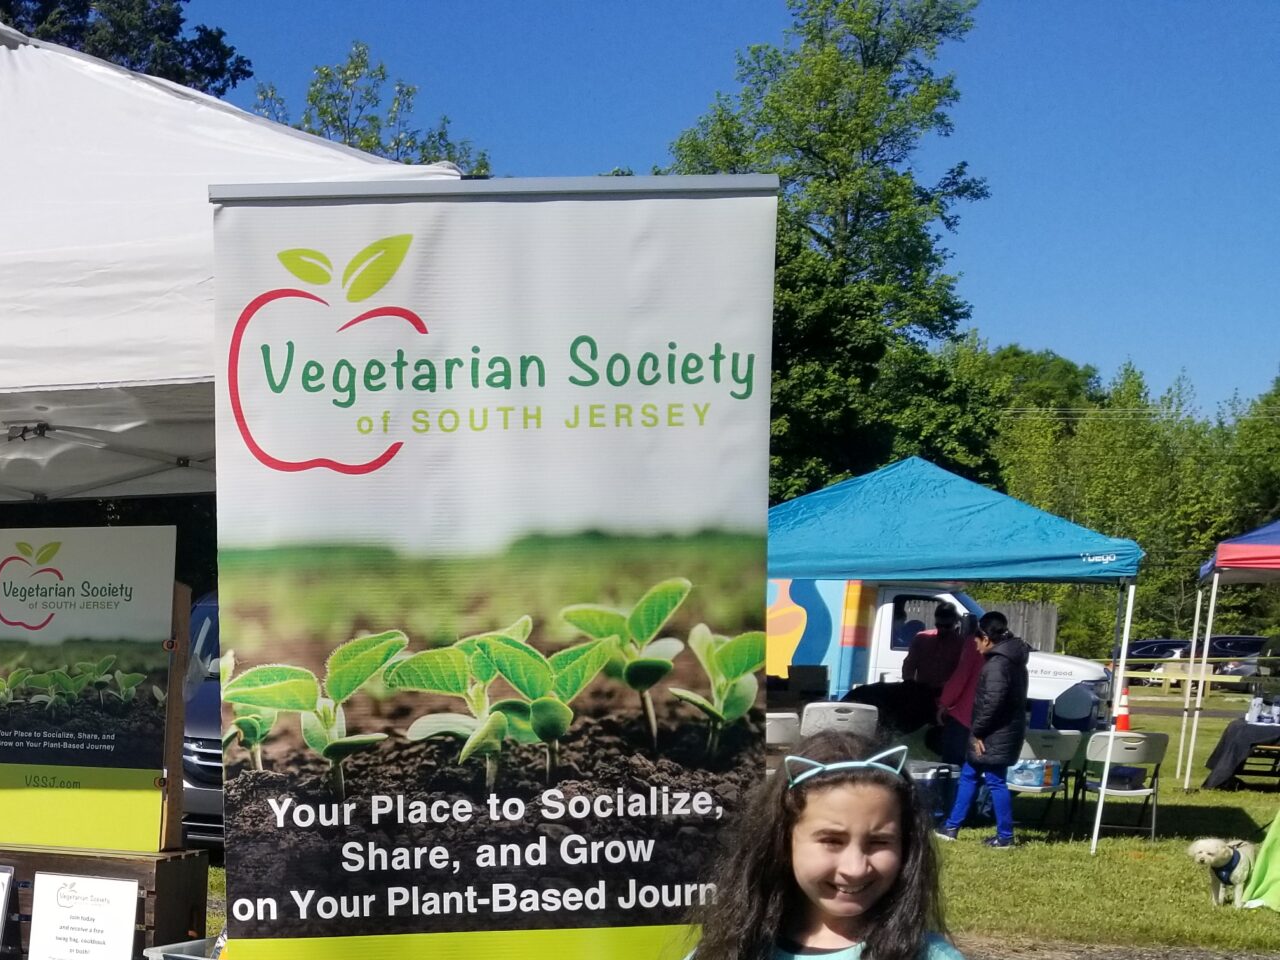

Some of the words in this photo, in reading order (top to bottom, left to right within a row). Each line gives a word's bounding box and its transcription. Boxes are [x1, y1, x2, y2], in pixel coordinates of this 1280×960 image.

[261, 340, 546, 408] Vegetarian
[568, 335, 756, 399] Society
[356, 409, 391, 434] of
[412, 405, 543, 433] SOUTH
[565, 402, 712, 429] JERSEY
[3, 580, 75, 602] Vegetarian
[81, 581, 133, 601] Society
[28, 602, 38, 610] of
[41, 601, 76, 609] SOUTH
[79, 601, 120, 609] JERSEY
[14, 730, 32, 738] Place
[42, 731, 76, 740] Socialize,
[77, 732, 100, 740] Share,
[26, 740, 41, 748] Your
[43, 741, 85, 750] Plant-Based
[86, 743, 115, 752] Journey
[24, 774, 81, 790] VSSJ.com
[268, 796, 358, 828] Your
[371, 794, 473, 824] Place
[487, 792, 521, 822] to
[541, 786, 724, 821] Socialize,
[341, 841, 461, 874] Share,
[475, 836, 549, 867] and
[560, 834, 656, 864] Grow
[232, 898, 278, 922] on
[290, 890, 377, 920] Your
[387, 880, 606, 916] Plant-Based
[618, 879, 719, 909] Journ
